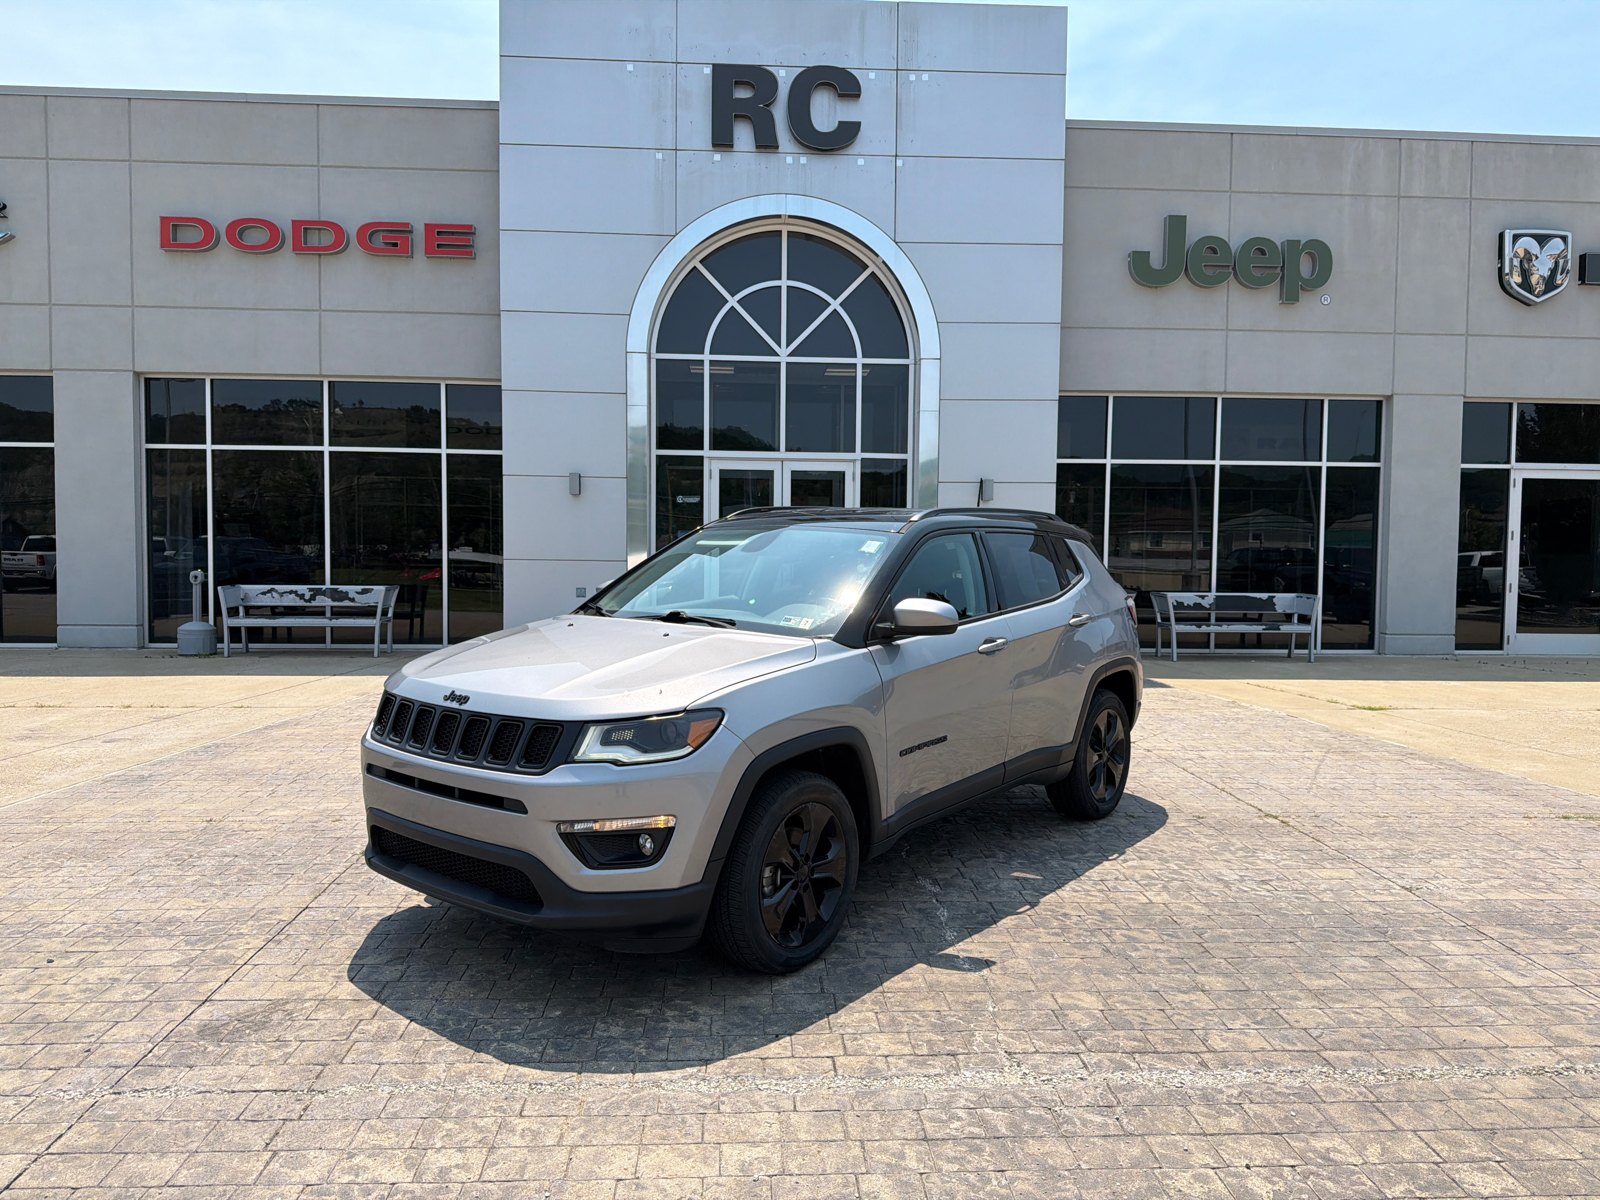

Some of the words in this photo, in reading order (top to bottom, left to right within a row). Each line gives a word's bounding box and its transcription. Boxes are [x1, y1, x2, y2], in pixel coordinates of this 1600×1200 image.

[711, 63, 862, 151] RC
[159, 215, 476, 259] DODGE
[1128, 214, 1334, 304] Jeep
[443, 690, 470, 706] Jeep
